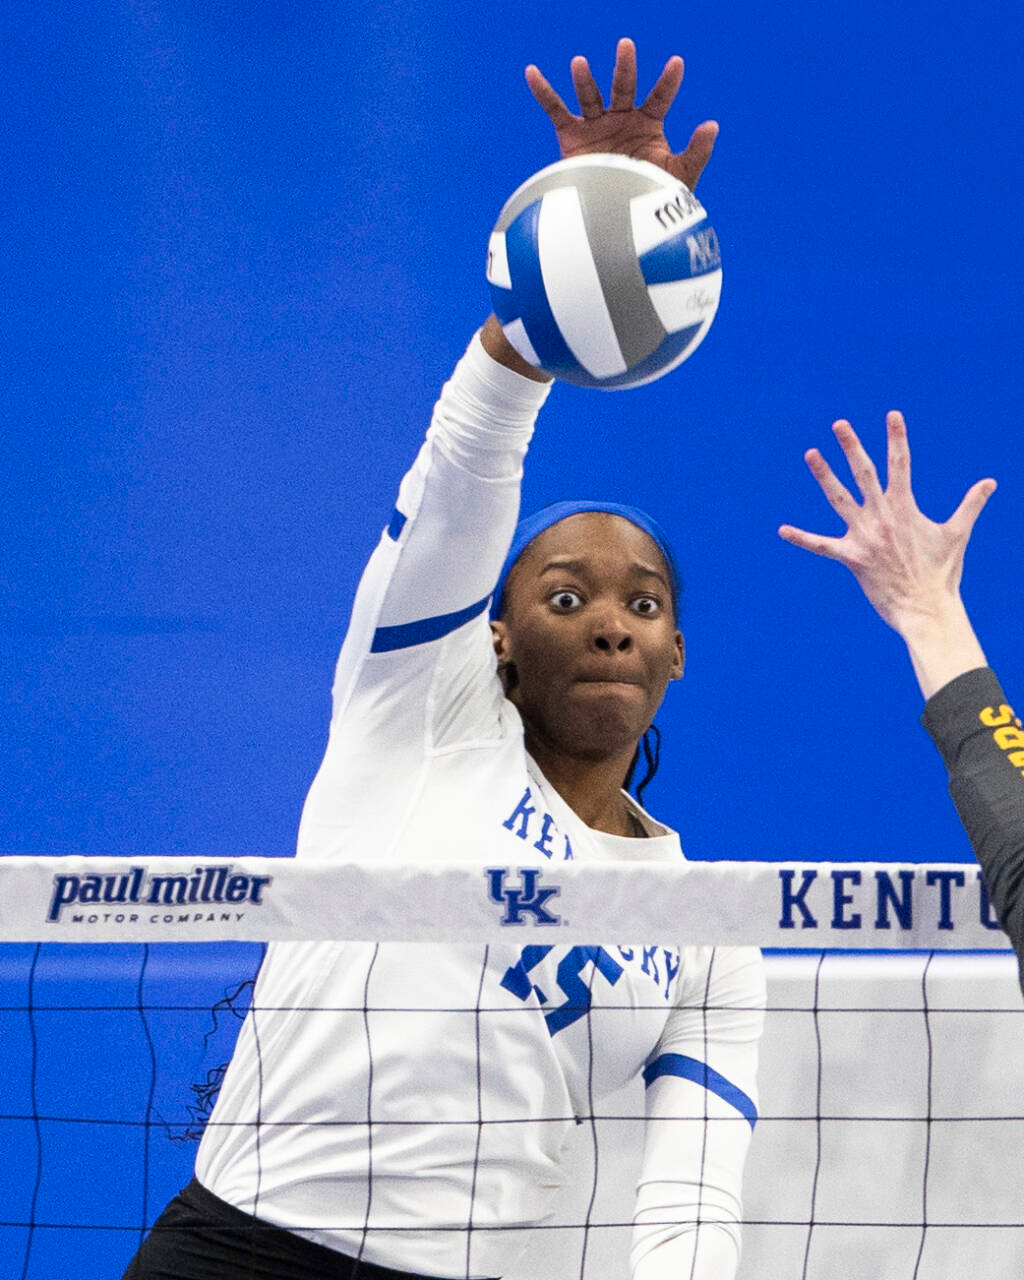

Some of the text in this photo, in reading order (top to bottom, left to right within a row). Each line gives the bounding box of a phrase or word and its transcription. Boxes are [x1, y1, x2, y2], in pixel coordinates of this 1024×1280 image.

[48, 866, 272, 922] paul miller
[72, 912, 246, 923] MOTOR COMPANY
